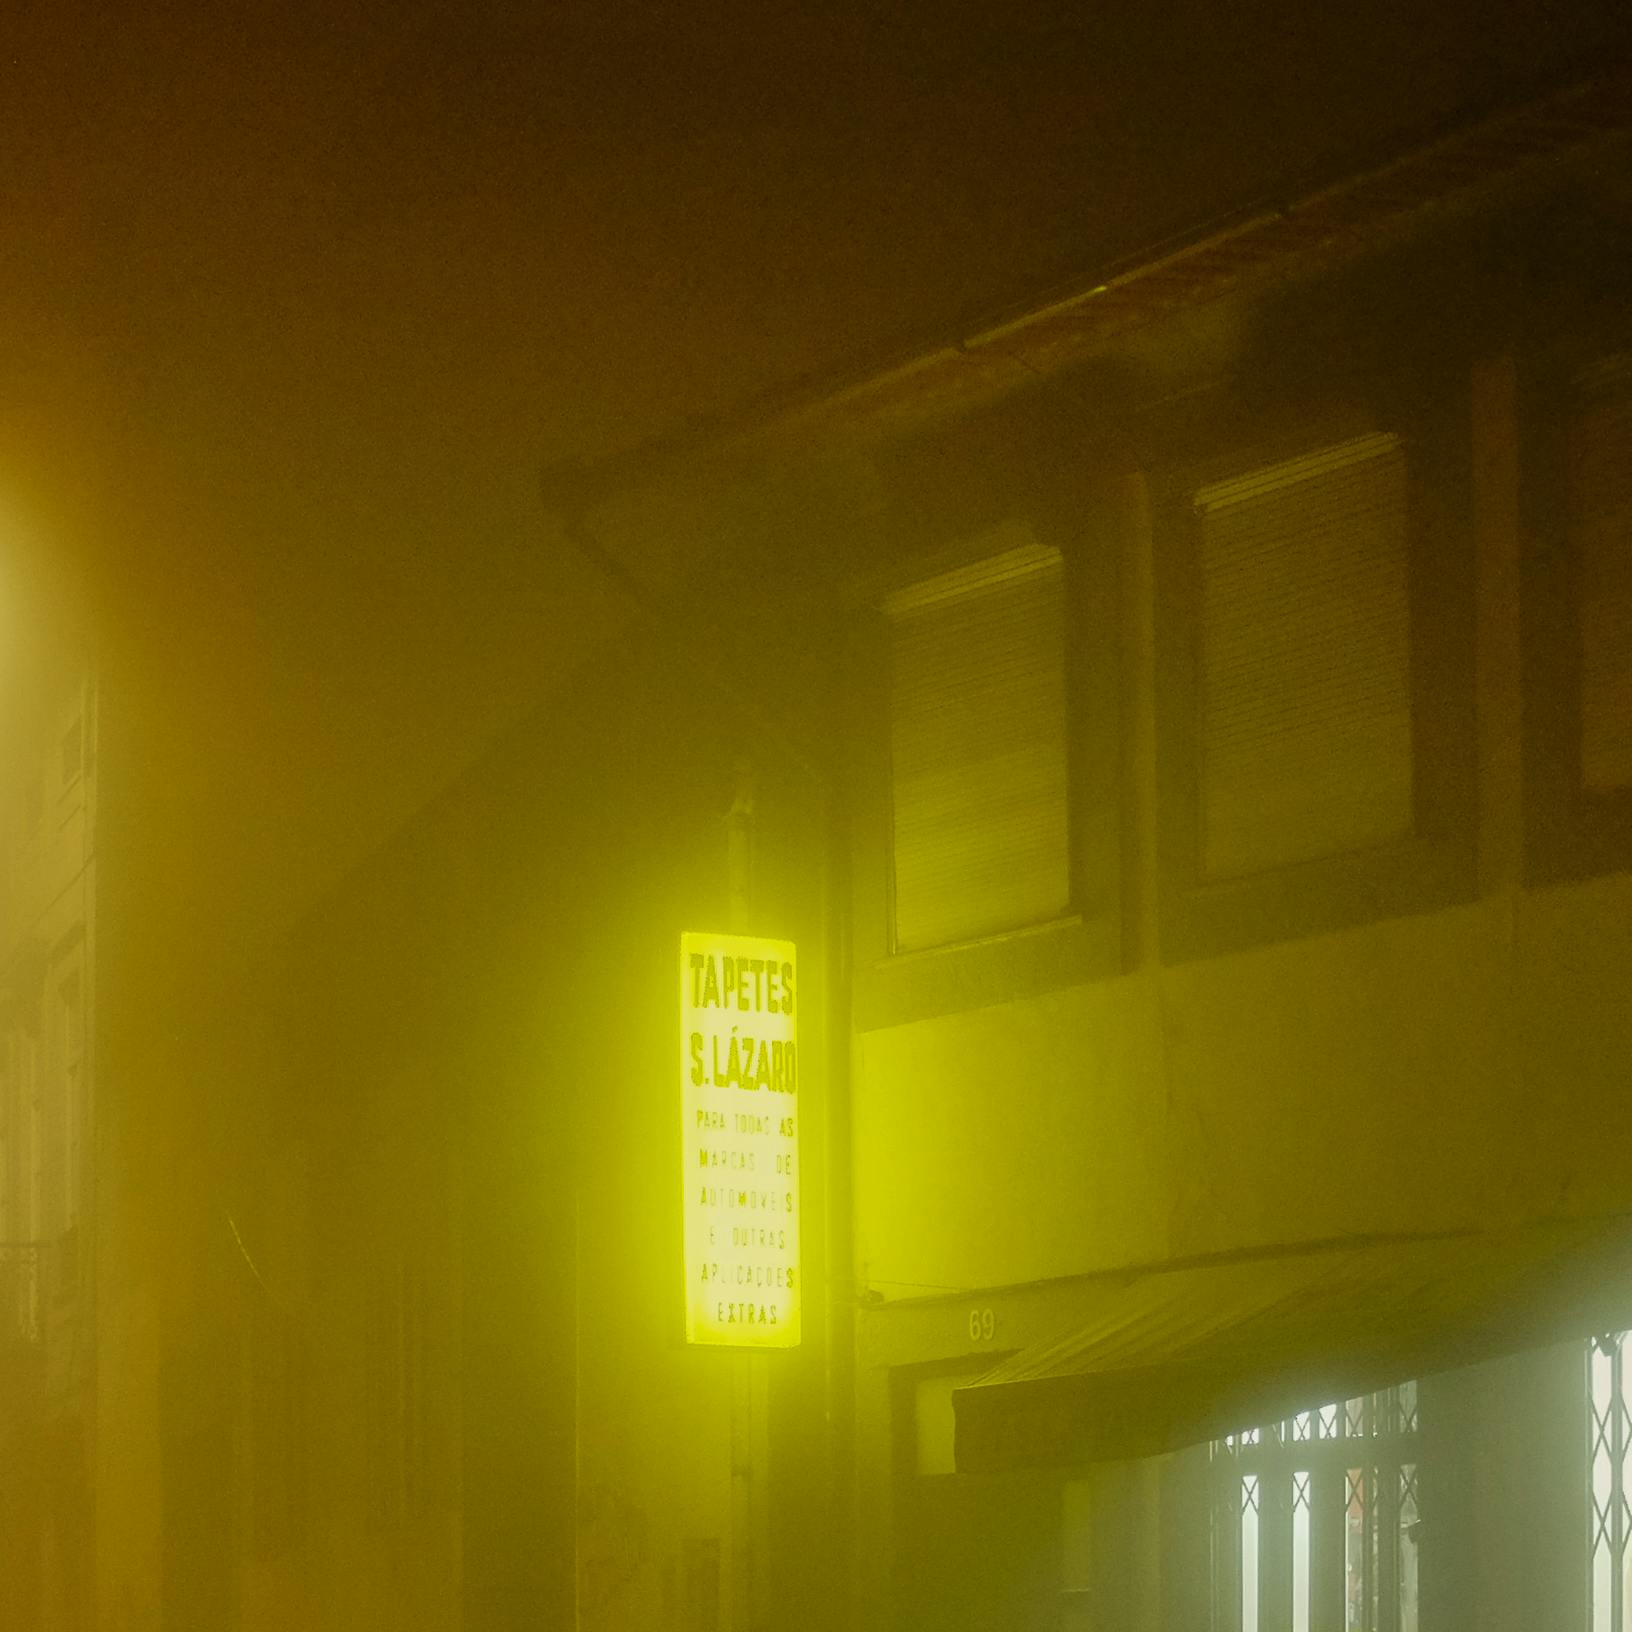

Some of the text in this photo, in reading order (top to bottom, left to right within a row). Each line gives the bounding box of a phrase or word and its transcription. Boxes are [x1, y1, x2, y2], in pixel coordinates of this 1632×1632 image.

[689, 953, 793, 1016] TAPETES
[696, 1109, 725, 1130] PARA
[779, 1117, 794, 1138] AS
[699, 1148, 792, 1176] MARCAS DE
[732, 1227, 785, 1250] OUTRAS
[718, 1301, 777, 1325] EXTRAS
[969, 1309, 994, 1340] 69
